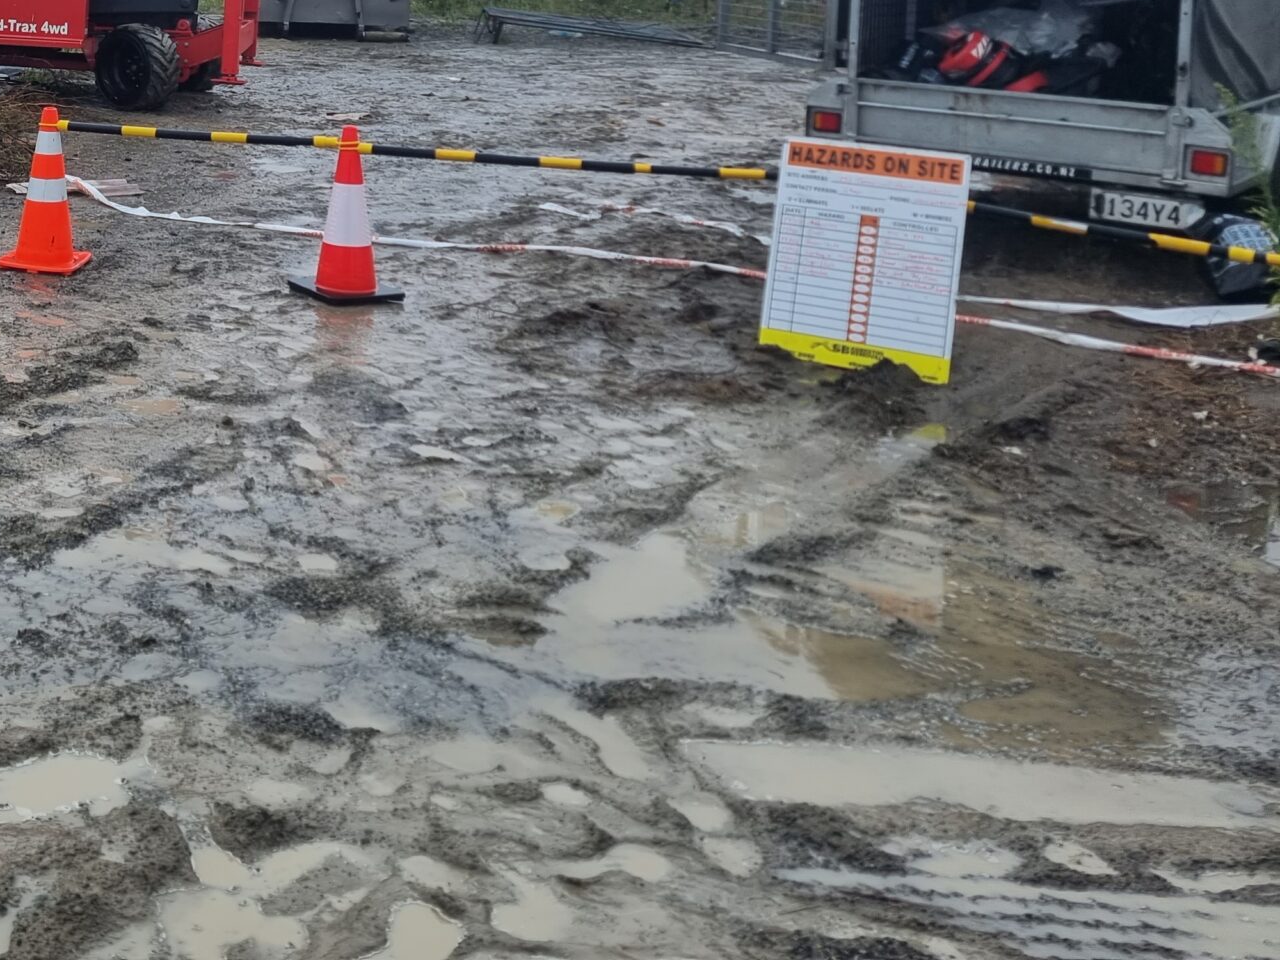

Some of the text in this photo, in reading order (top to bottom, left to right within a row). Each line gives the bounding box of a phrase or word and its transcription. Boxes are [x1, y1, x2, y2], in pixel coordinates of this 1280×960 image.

[41, 21, 68, 35] 4wd
[790, 146, 961, 181] HAZARDS ON SITE
[973, 157, 1076, 177] RAILERS.CO.NZ
